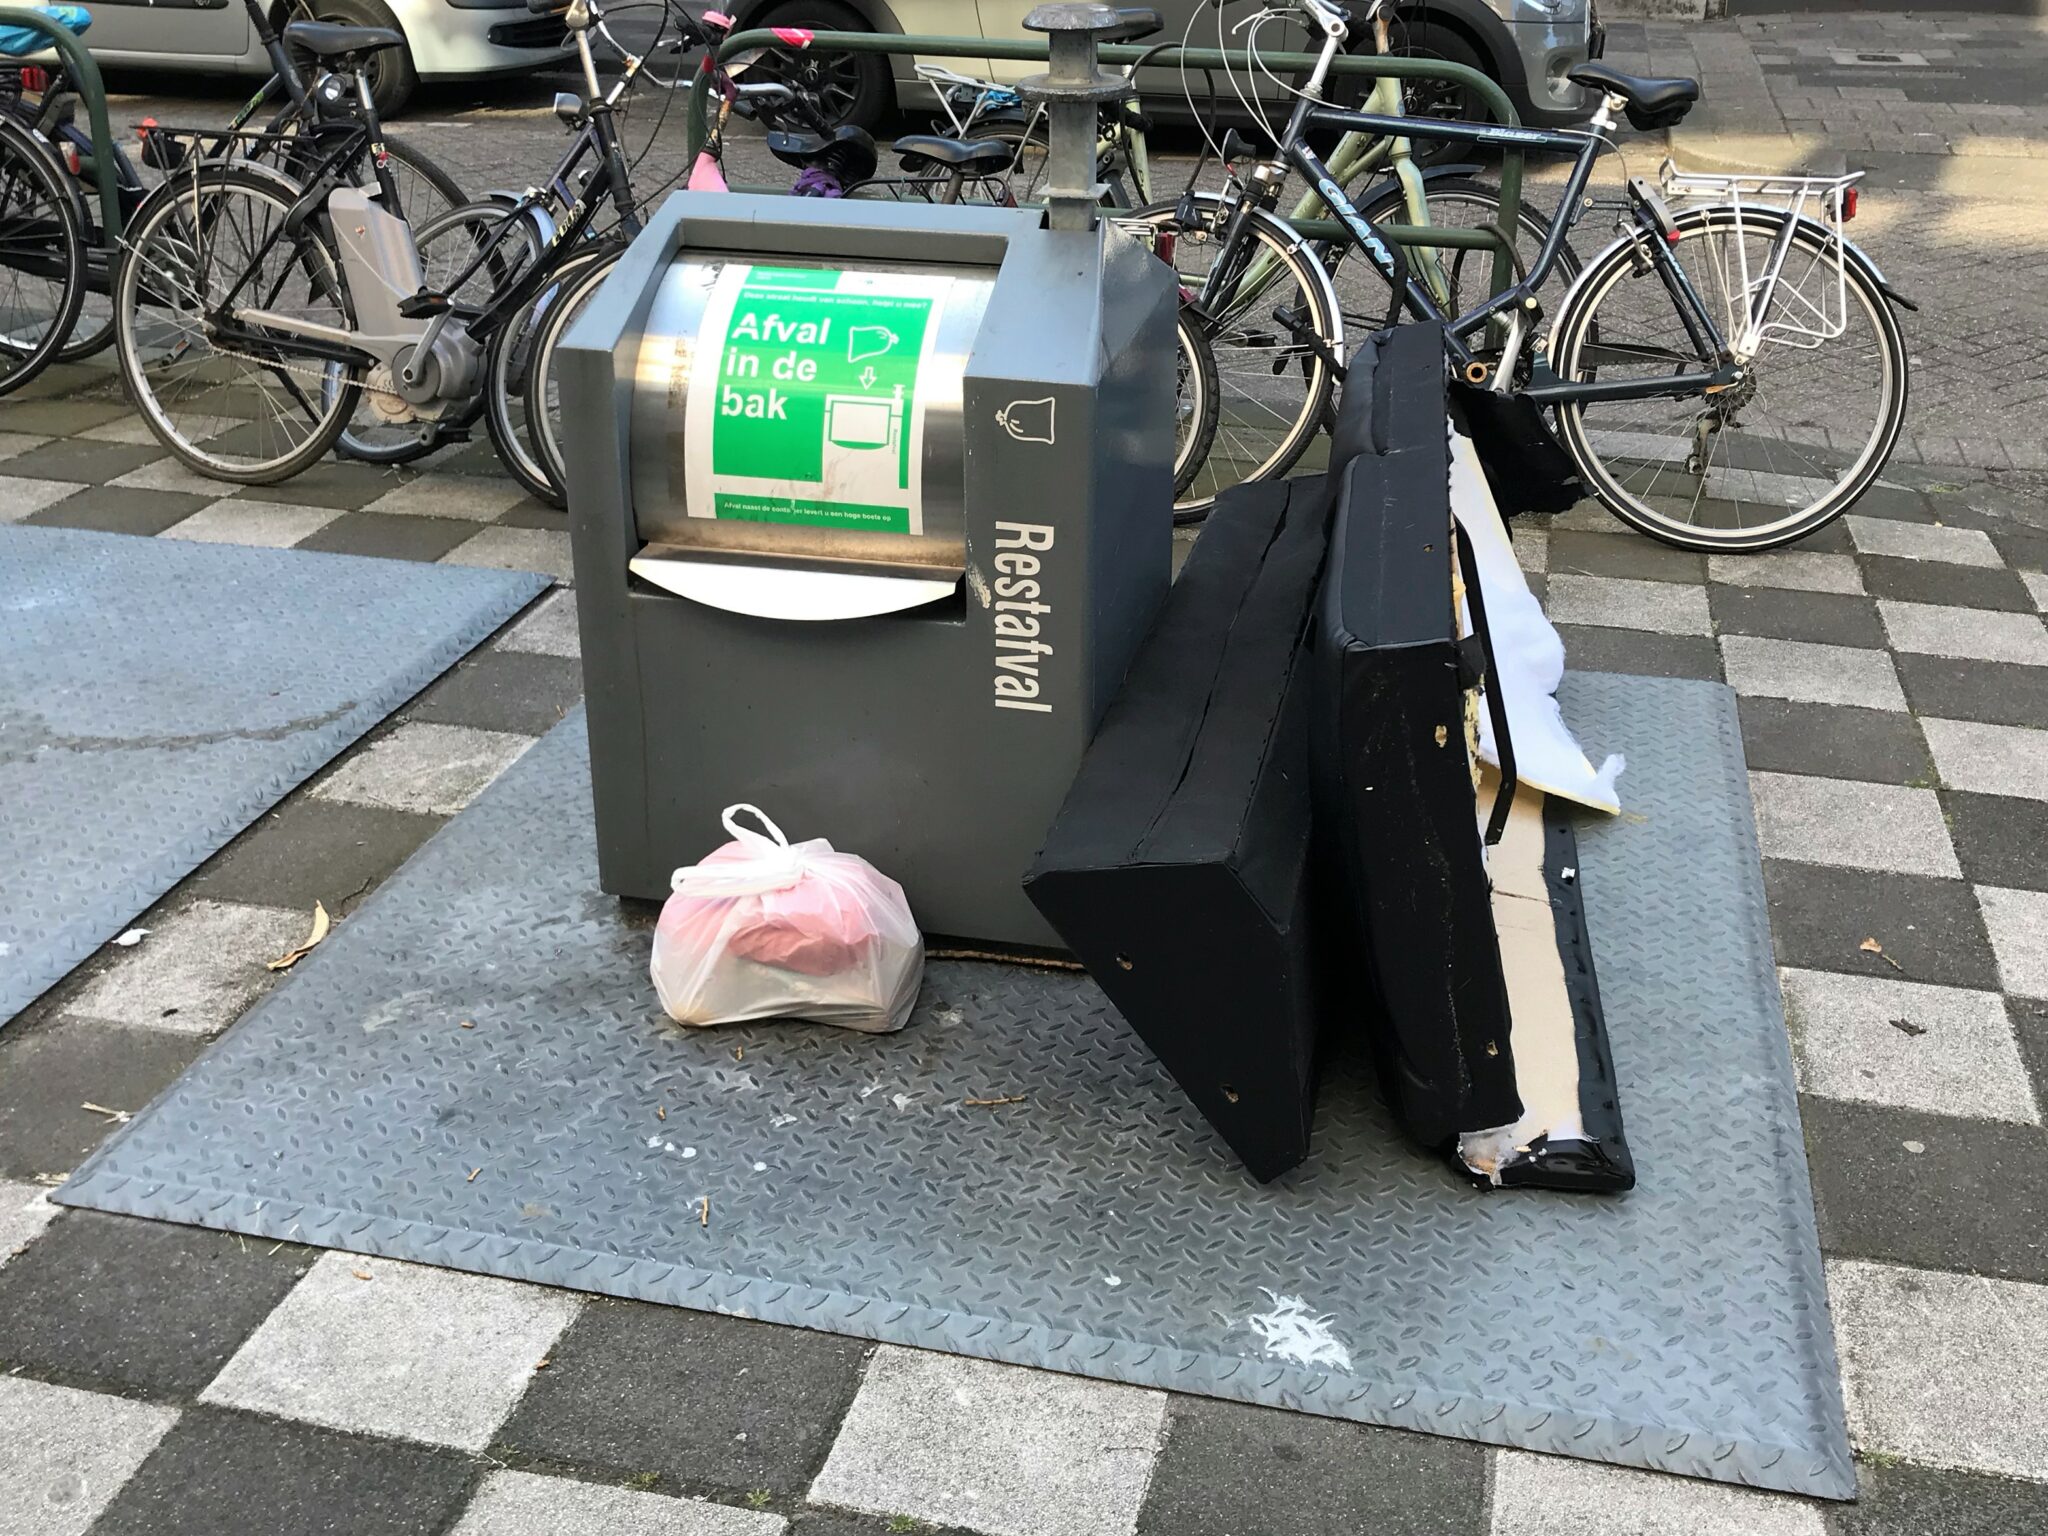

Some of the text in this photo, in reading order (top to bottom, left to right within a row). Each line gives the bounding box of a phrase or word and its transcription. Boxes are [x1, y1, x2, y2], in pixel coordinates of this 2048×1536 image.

[731, 312, 831, 345] Afval
[726, 347, 818, 382] in de
[721, 384, 789, 420] bak
[724, 502, 742, 510] Afval
[742, 503, 761, 512] naast
[762, 504, 771, 512] de
[804, 507, 824, 516] levert
[844, 512, 861, 520] hoge
[862, 513, 881, 521] boete
[882, 515, 892, 523] op
[994, 521, 1055, 713] Restafval
